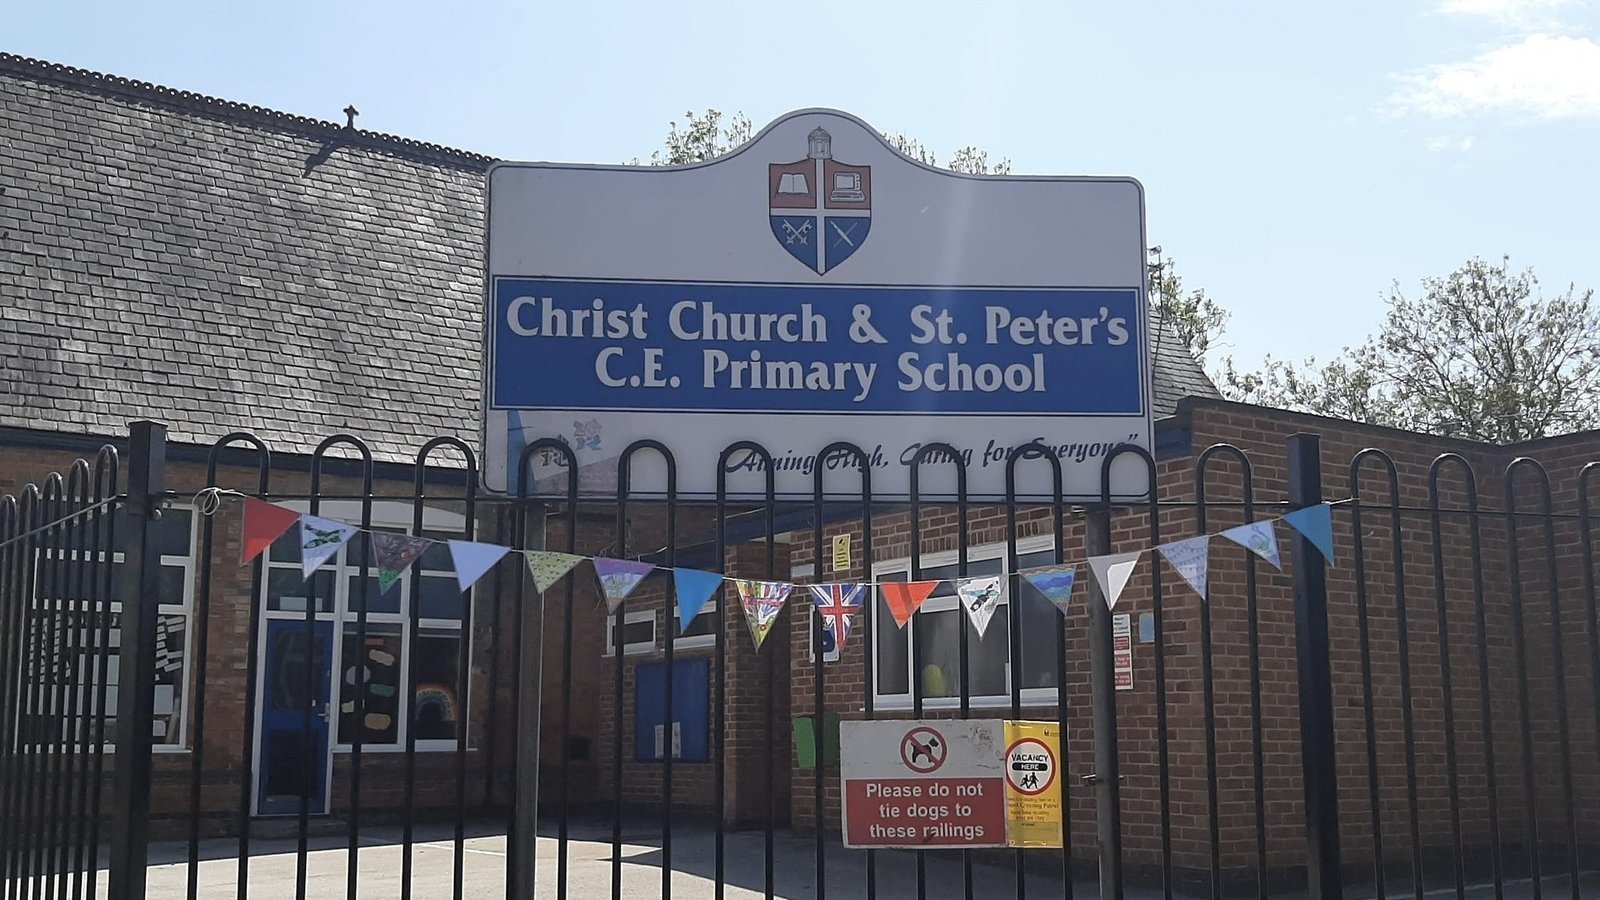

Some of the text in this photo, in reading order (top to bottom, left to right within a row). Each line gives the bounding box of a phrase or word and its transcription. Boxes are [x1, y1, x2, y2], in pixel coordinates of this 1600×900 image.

[507, 297, 1128, 345] Christ Church & St. Peter's
[596, 347, 1045, 401] C.E. Primary School
[1011, 753, 1049, 763] VACANCY
[867, 783, 983, 797] Please do not
[879, 803, 971, 820] tie dogs to
[870, 823, 984, 840] these railings
